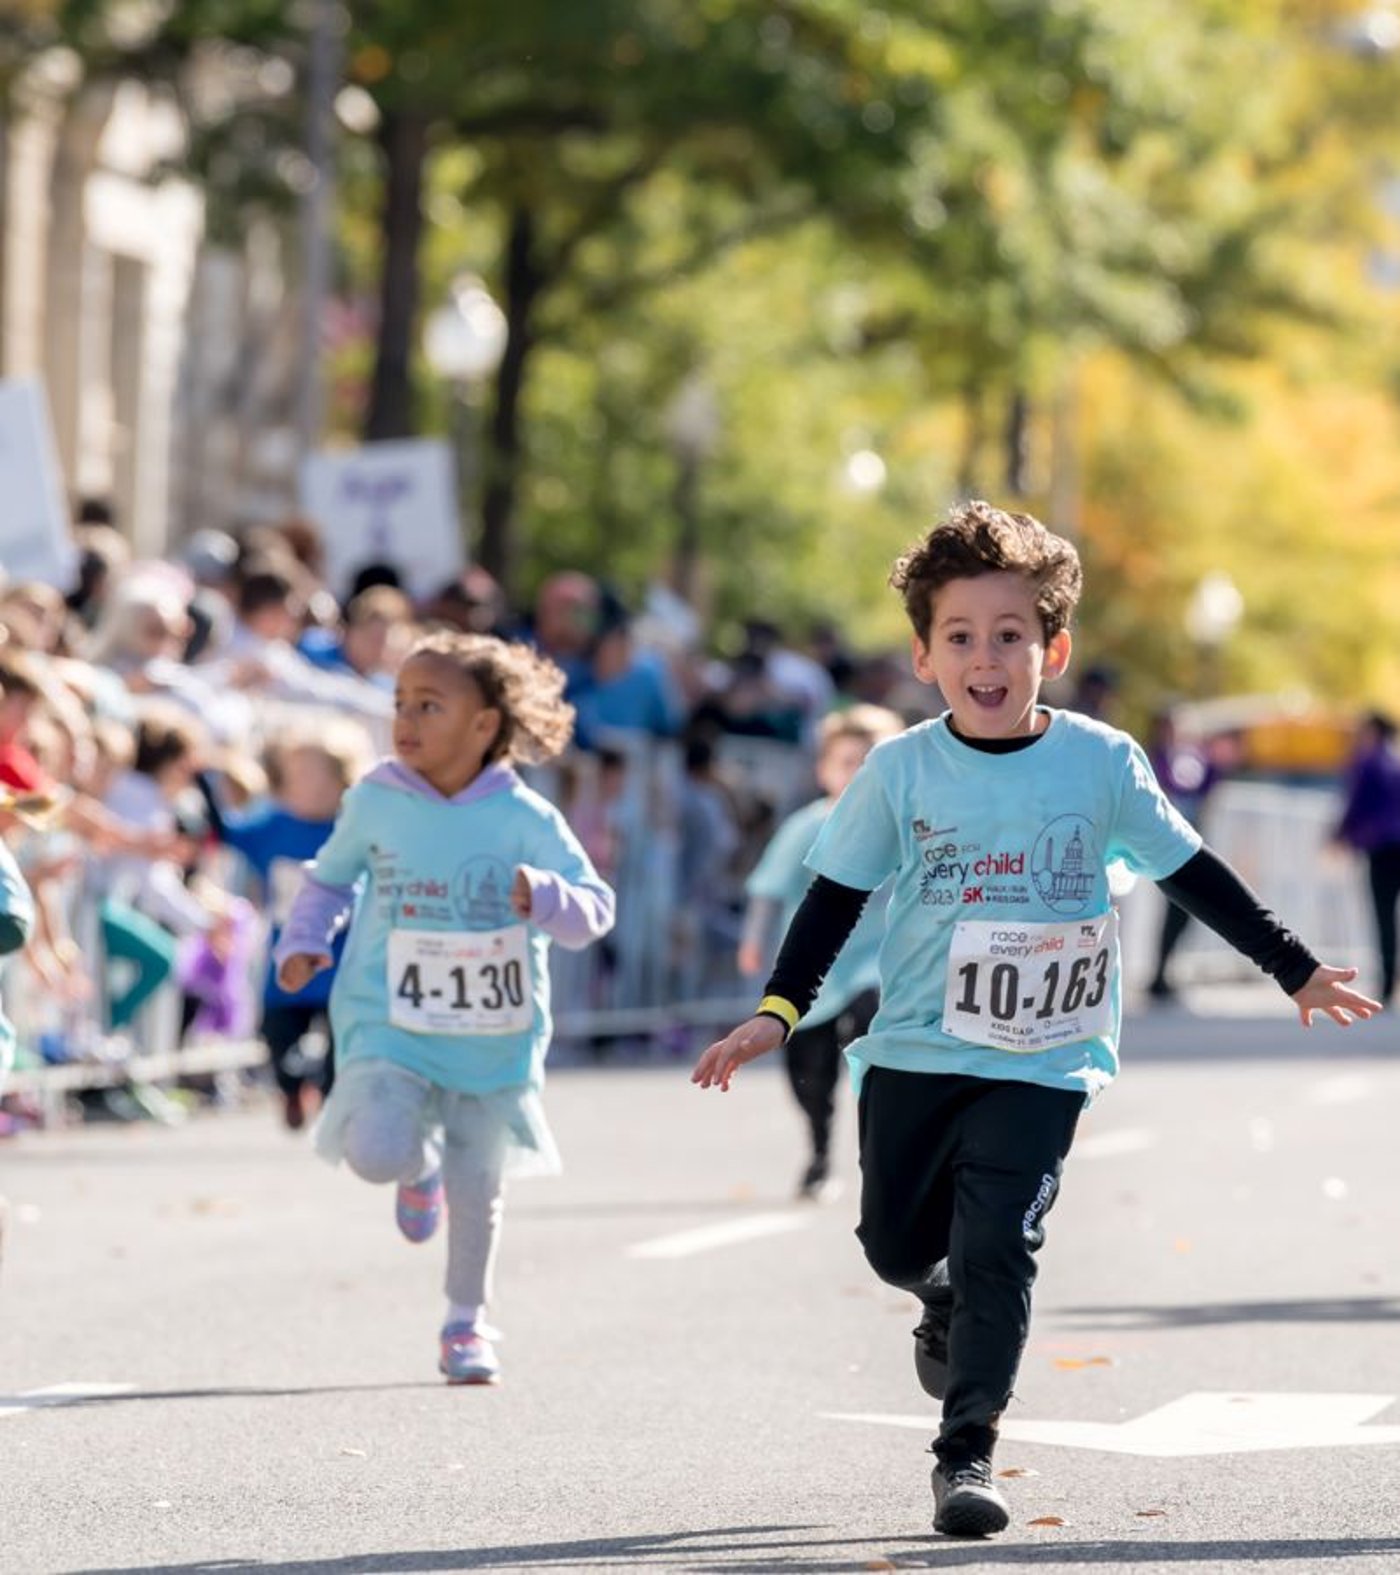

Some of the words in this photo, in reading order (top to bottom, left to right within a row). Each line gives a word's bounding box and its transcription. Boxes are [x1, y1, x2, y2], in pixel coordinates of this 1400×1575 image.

[974, 851, 1025, 876] child
[962, 887, 984, 904] 5K
[990, 944, 1033, 959] every
[1033, 936, 1065, 954] child
[992, 932, 1028, 943] race
[398, 960, 524, 1009] 4-130
[956, 948, 1108, 1021] 10-163
